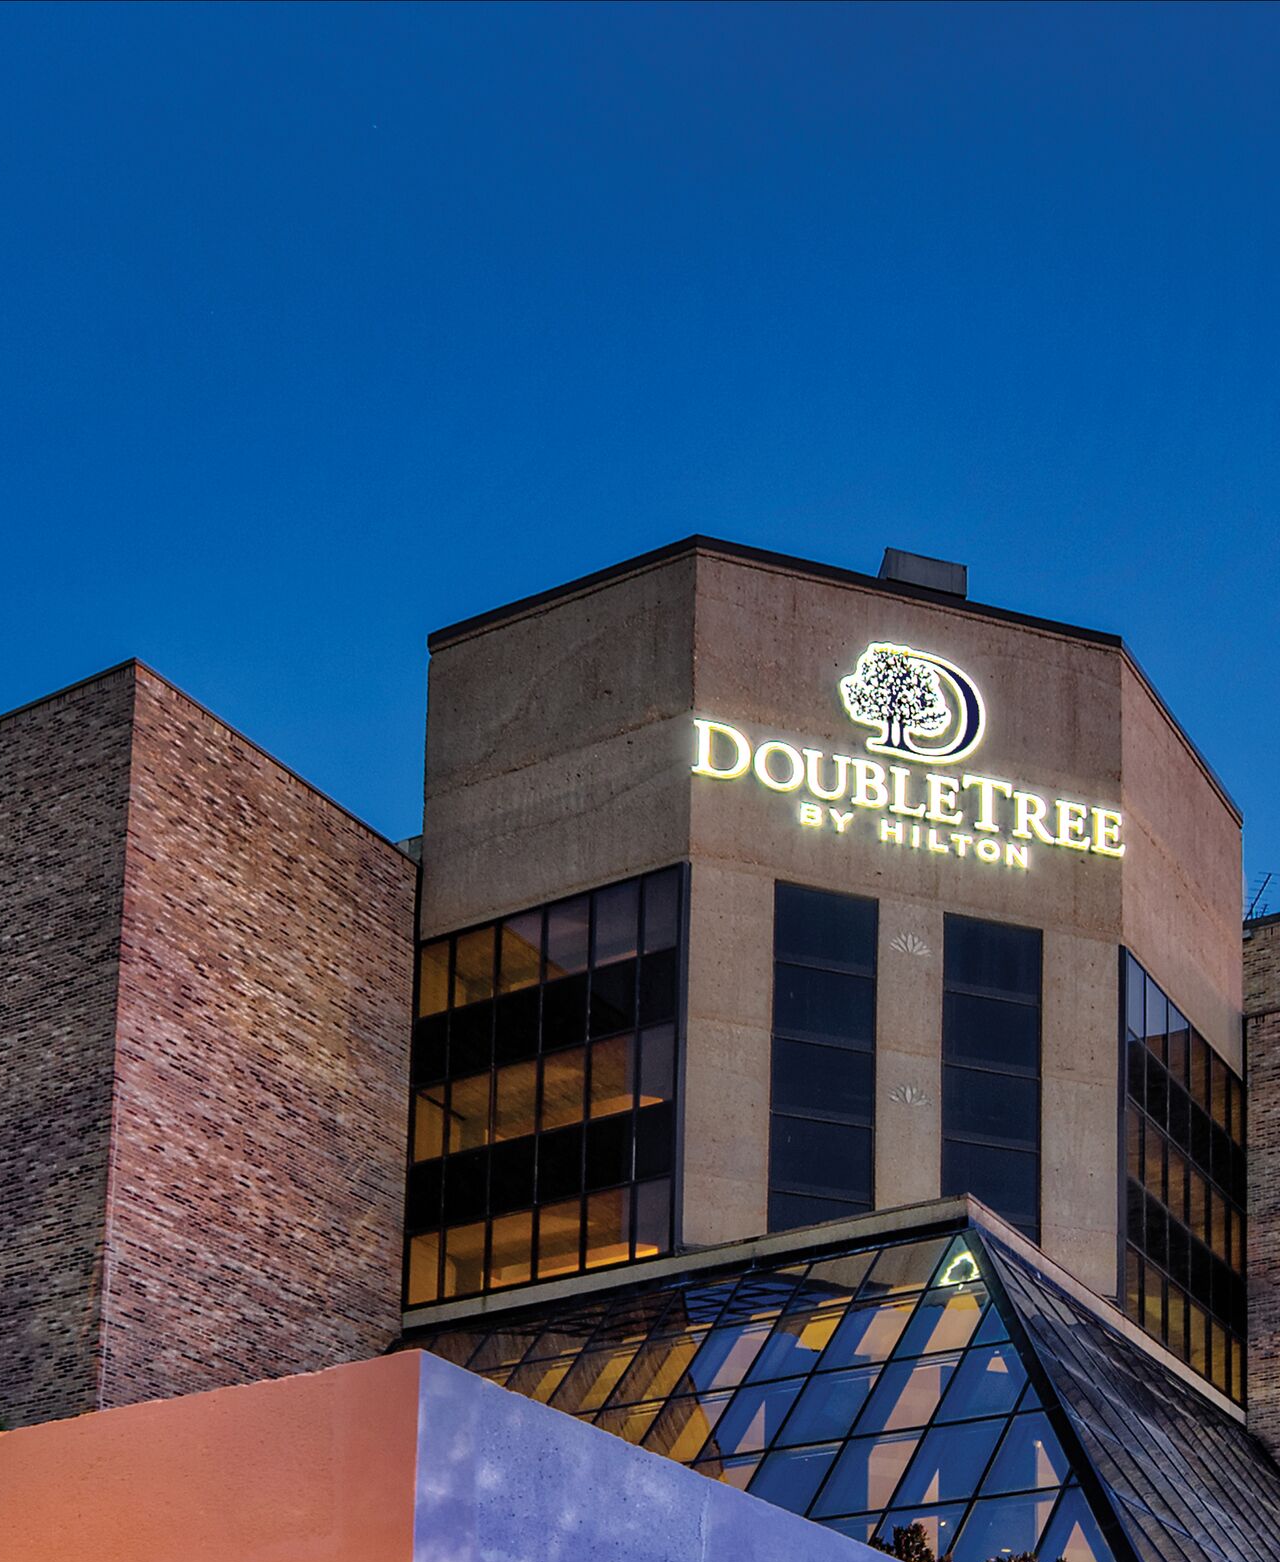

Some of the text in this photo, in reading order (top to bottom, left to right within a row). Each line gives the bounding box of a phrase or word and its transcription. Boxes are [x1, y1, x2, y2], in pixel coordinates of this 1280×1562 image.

[690, 718, 1127, 858] DOUBLETREE
[799, 802, 1030, 869] BY HILTON
